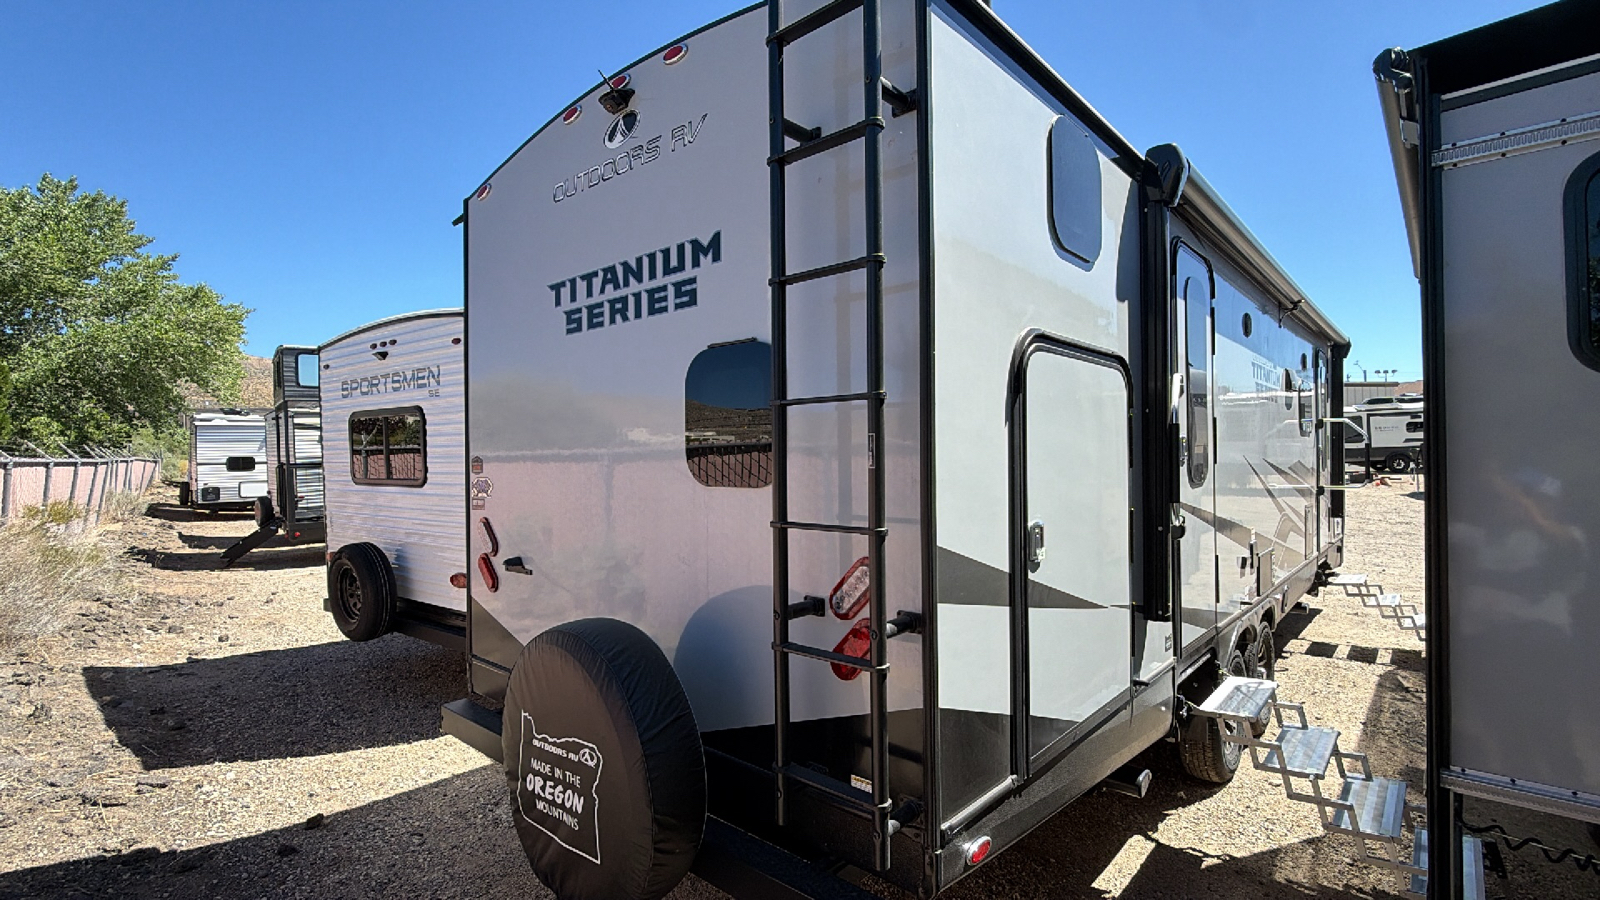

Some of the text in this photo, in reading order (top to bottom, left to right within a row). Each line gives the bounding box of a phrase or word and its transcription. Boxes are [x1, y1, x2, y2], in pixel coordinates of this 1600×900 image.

[552, 112, 709, 203] OUTDOORS RV
[546, 229, 722, 308] TITANIUM
[562, 274, 698, 336] SERIES
[341, 364, 441, 399] SPORTSMEN
[428, 388, 440, 398] SE
[532, 738, 567, 758] OUTDOORS
[530, 757, 581, 788] MADE IN THE
[526, 773, 585, 814] OREGON
[536, 798, 579, 831] MOUNTAINS
